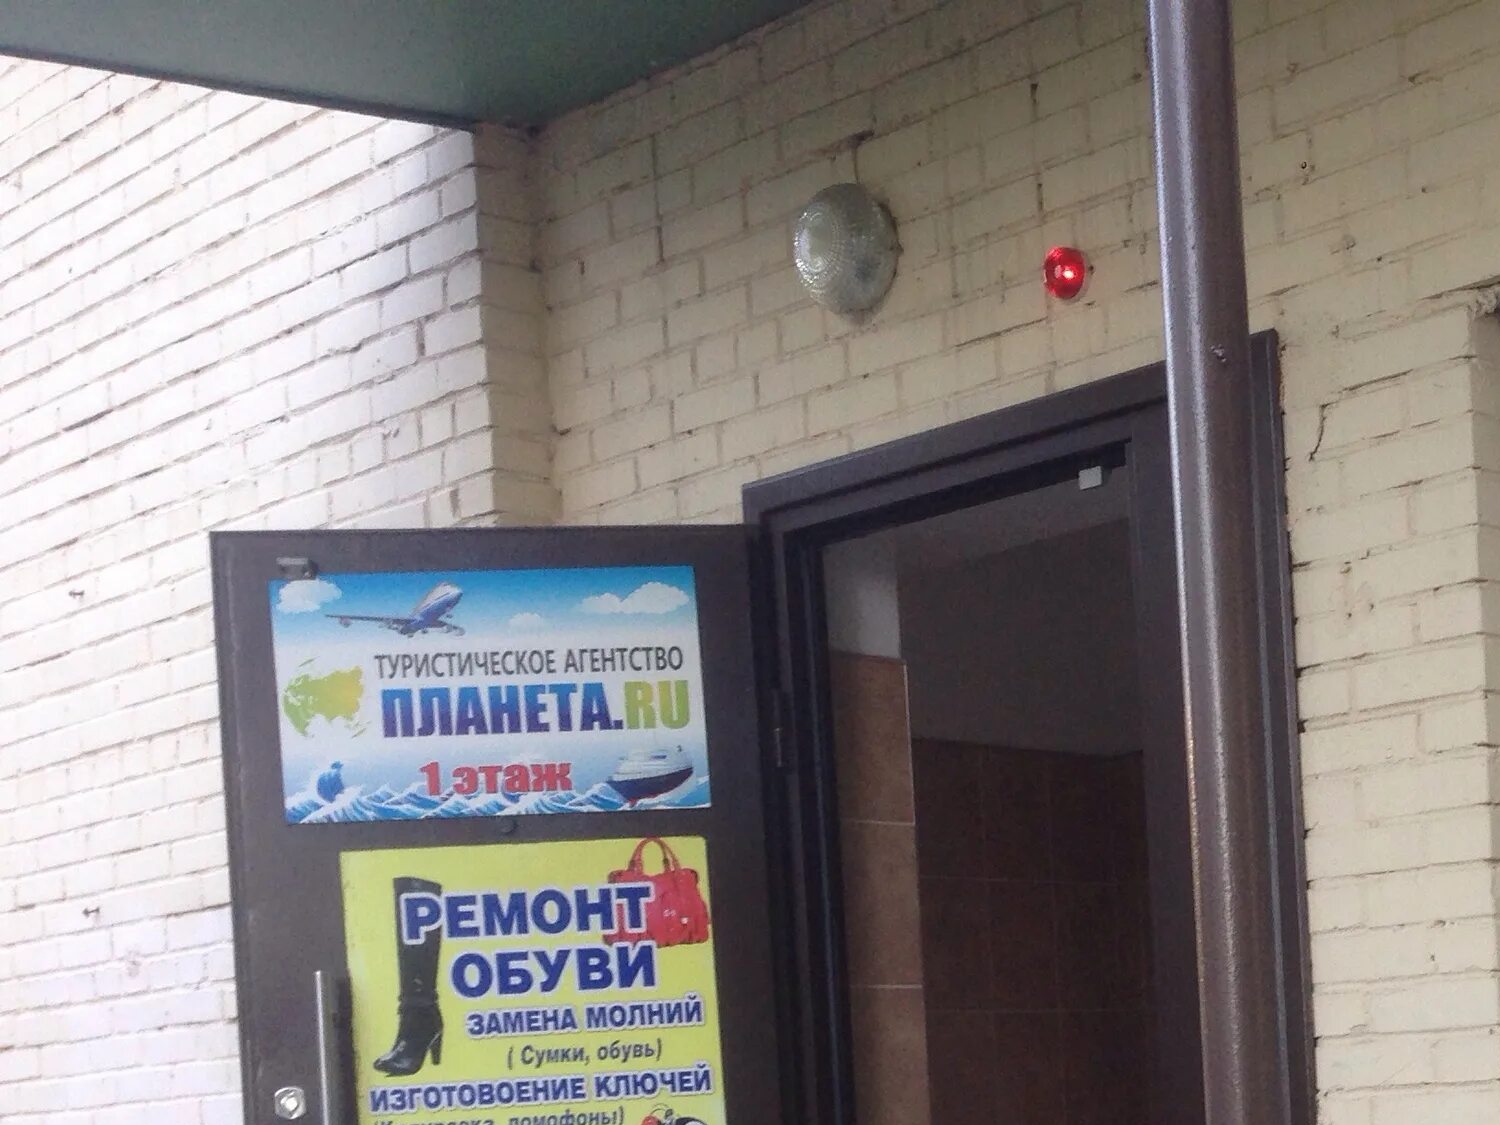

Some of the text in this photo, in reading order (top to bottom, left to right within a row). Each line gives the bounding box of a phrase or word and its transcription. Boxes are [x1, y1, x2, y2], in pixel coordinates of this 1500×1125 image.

[374, 646, 683, 679] ТУРИСТИЧЕСКОЕ АГЕНТСТВО
[381, 680, 690, 738] ПЛАНЕТА.RU
[419, 762, 573, 795] 1 этаж
[404, 886, 651, 941] РЕМОНТ
[451, 946, 656, 998] ОБУВИ
[467, 994, 703, 1036] ЗАМЕНА МОЛНИЙ
[597, 1038, 663, 1062] обувь)
[370, 1065, 712, 1111] ИЗГОТОВОЕНИЕ КЛЮЧЕЙ
